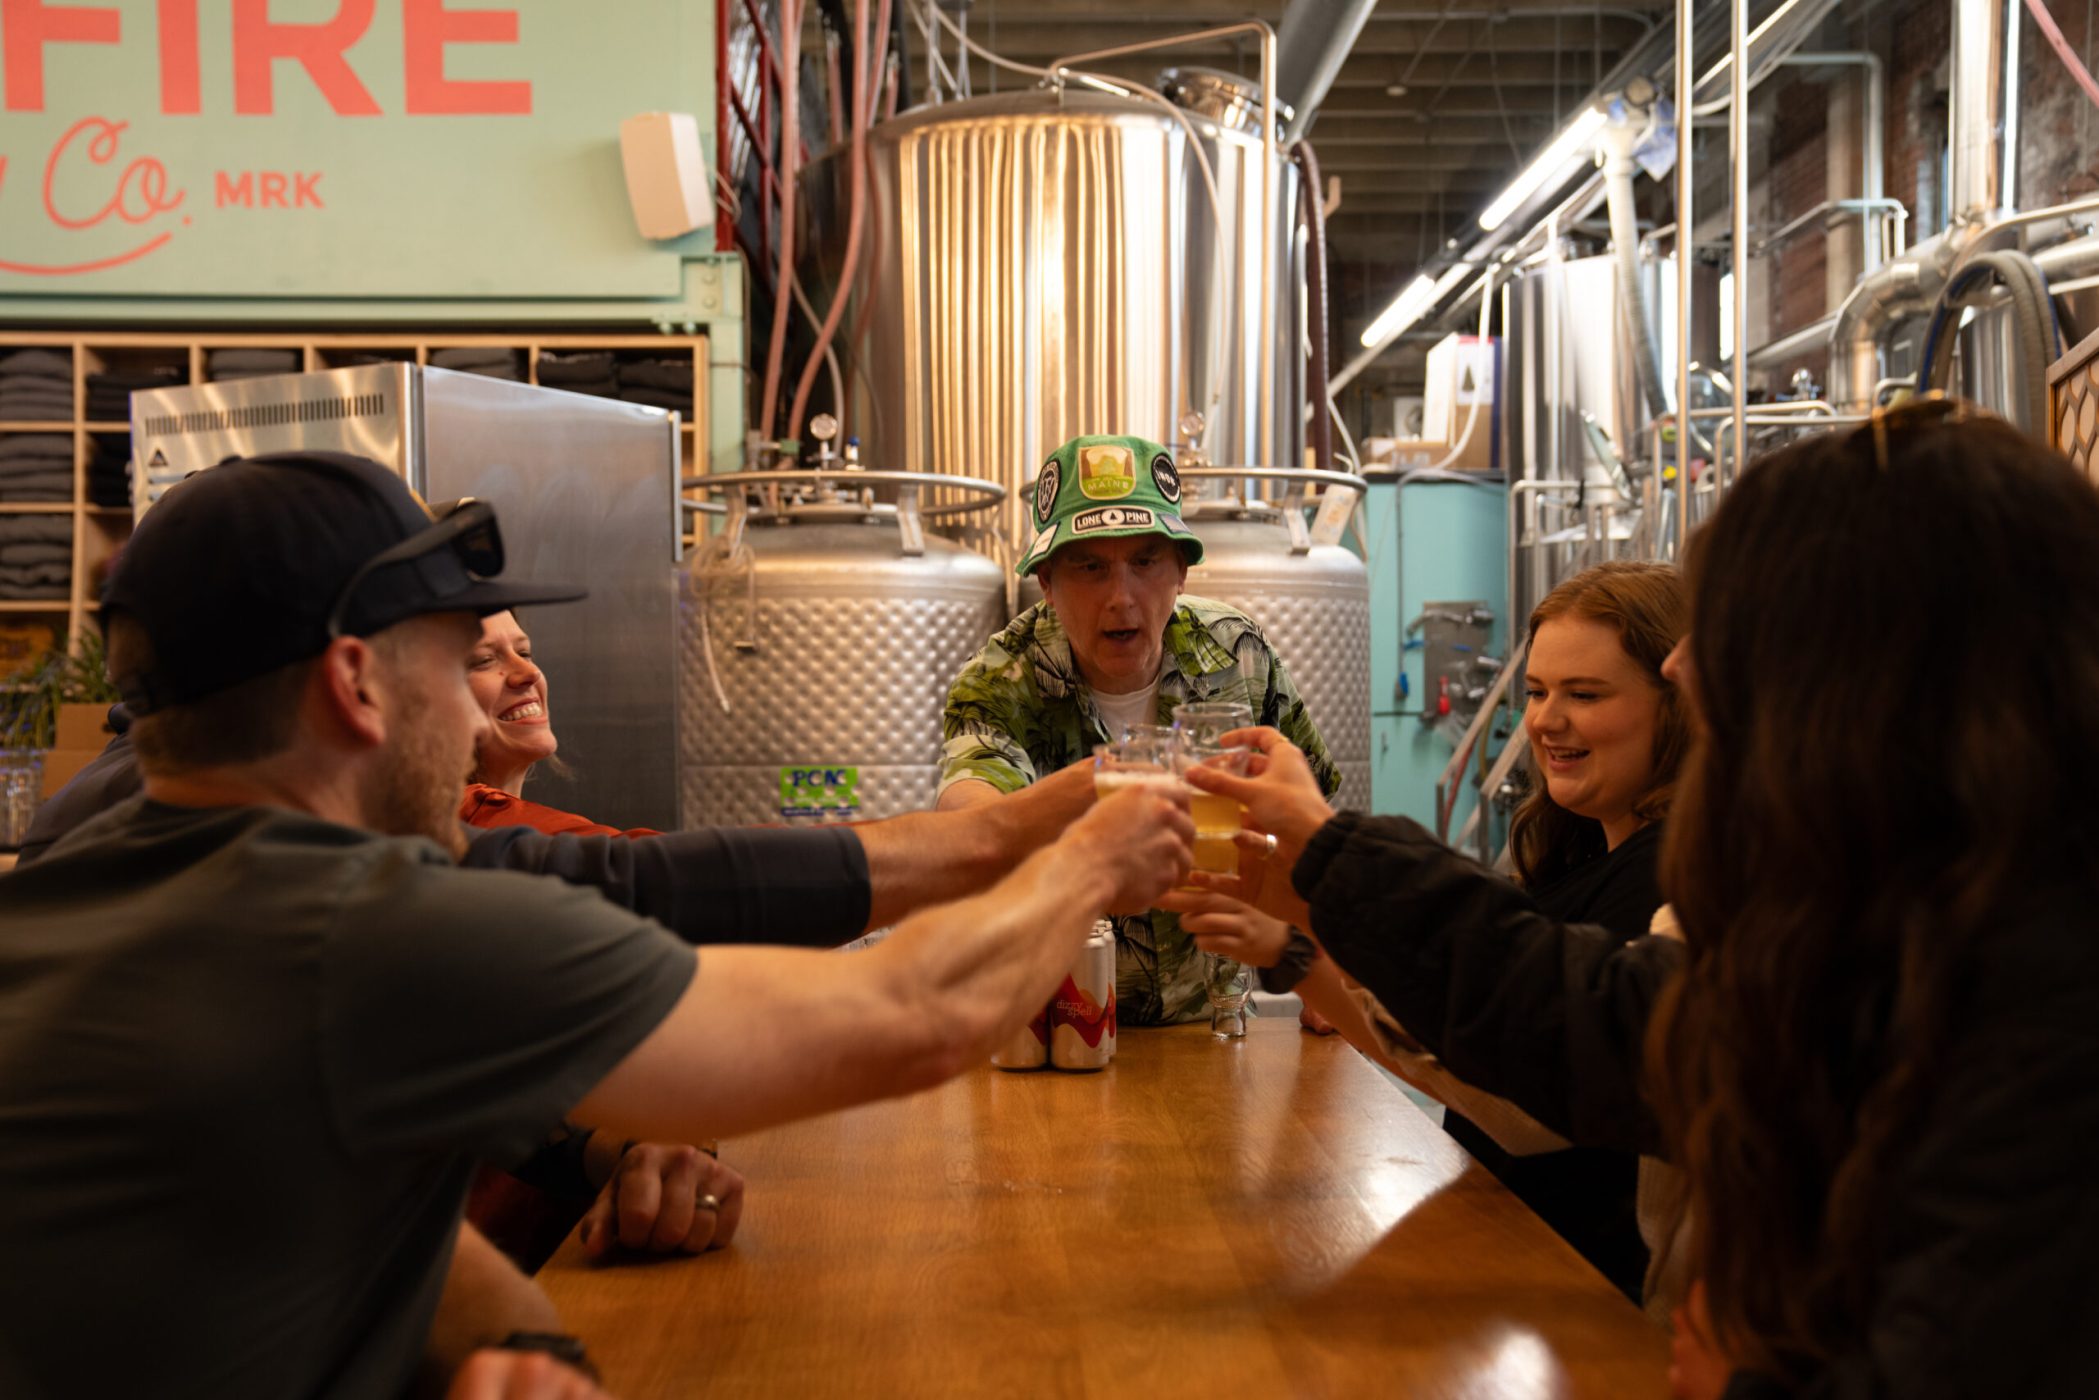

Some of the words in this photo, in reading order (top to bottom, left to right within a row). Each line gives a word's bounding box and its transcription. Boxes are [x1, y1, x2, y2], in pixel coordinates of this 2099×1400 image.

[42, 115, 192, 230] Co.
[213, 170, 325, 208] MRK
[1077, 513, 1102, 530] LONE
[1125, 511, 1150, 524] PINE
